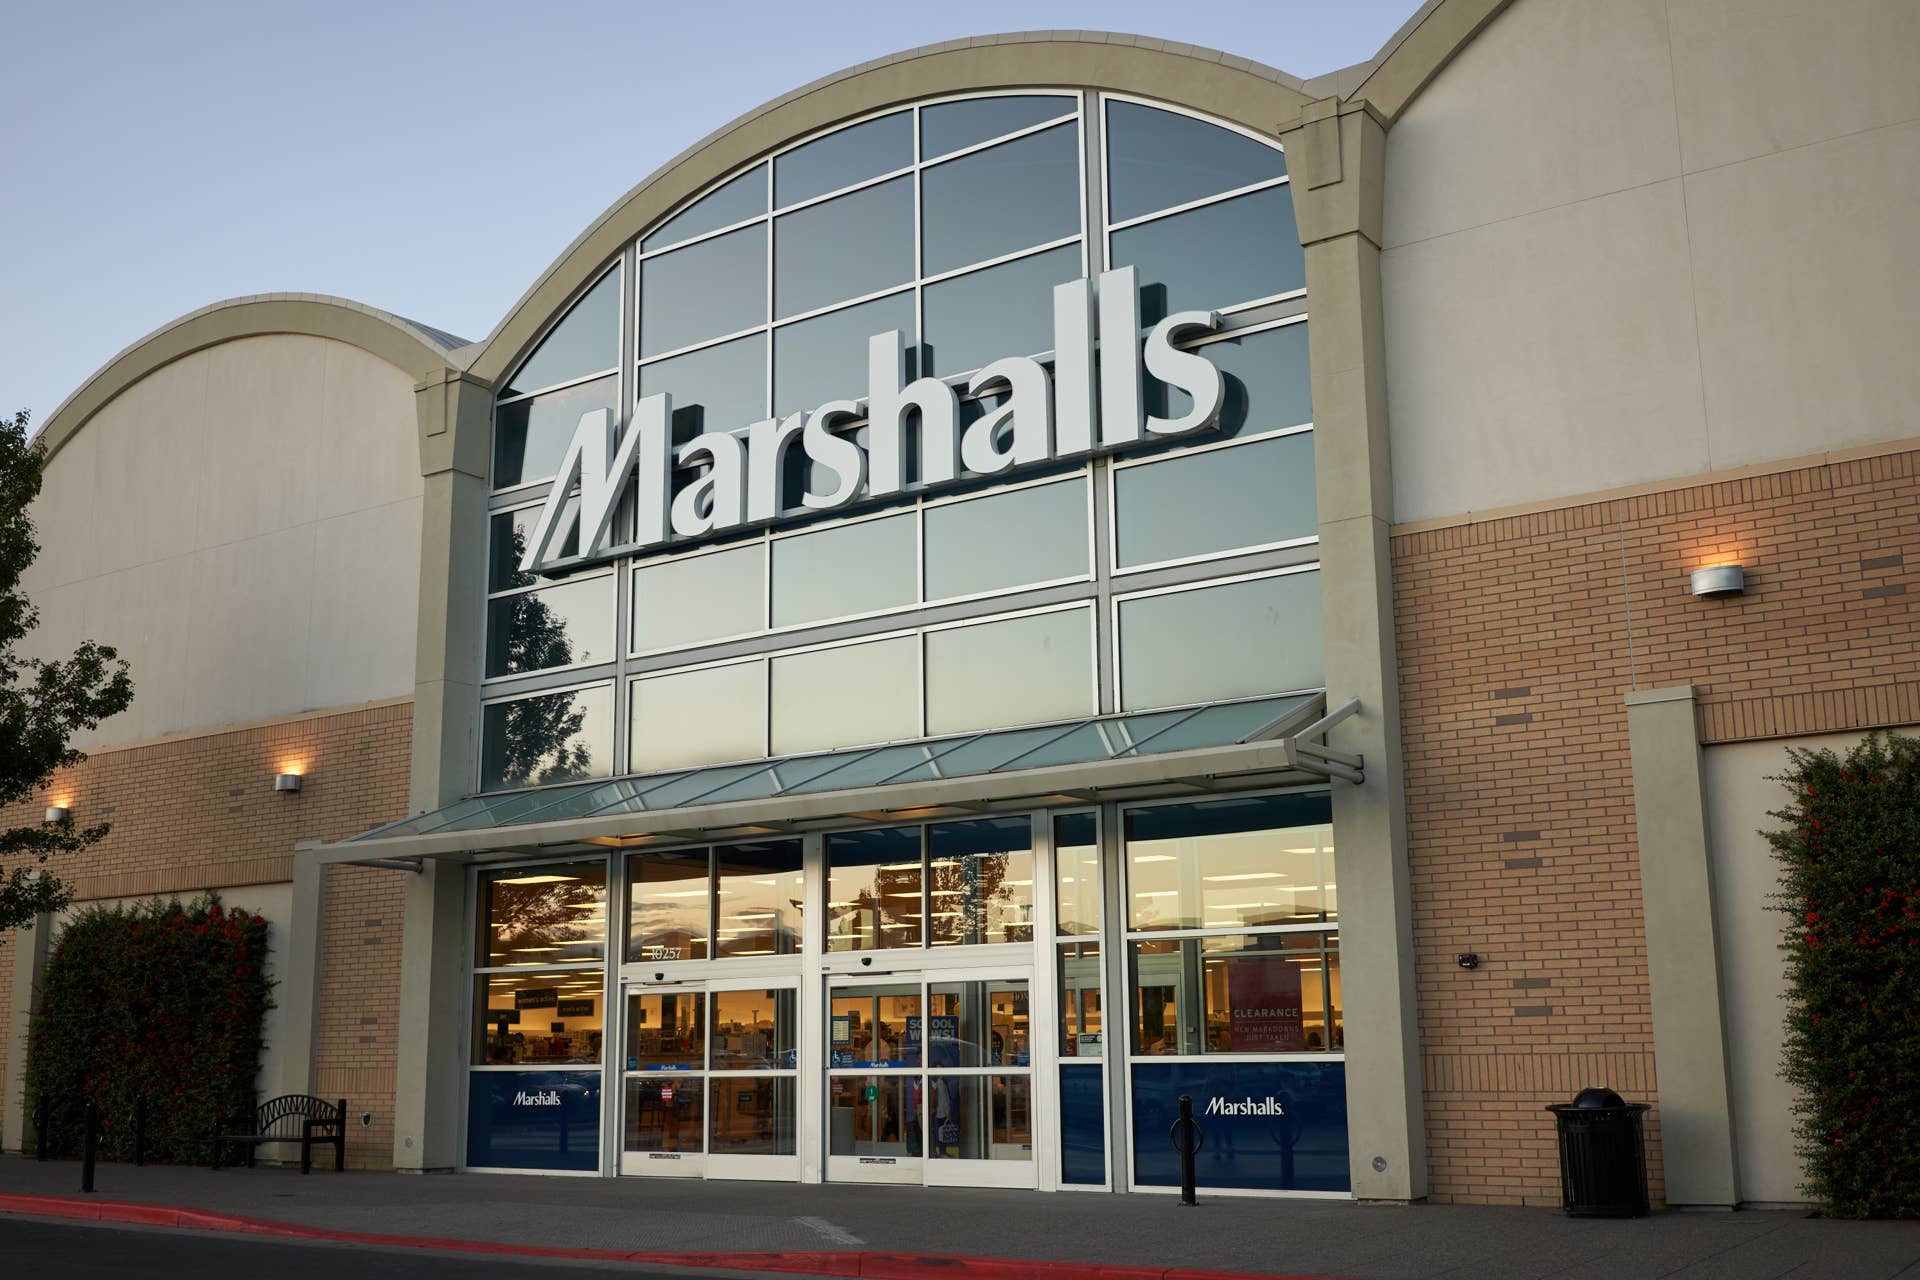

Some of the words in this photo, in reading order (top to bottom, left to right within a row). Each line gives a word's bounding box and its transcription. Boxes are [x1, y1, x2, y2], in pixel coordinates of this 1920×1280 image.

[519, 264, 1224, 573] Marshalls
[651, 947, 682, 960] 10257
[1233, 1007, 1299, 1018] CLEARANCE
[909, 1018, 955, 1029] SCOOL
[909, 1029, 955, 1041] WWS!
[513, 1090, 561, 1106] Marshalls
[1205, 1096, 1283, 1116] Marshalls
